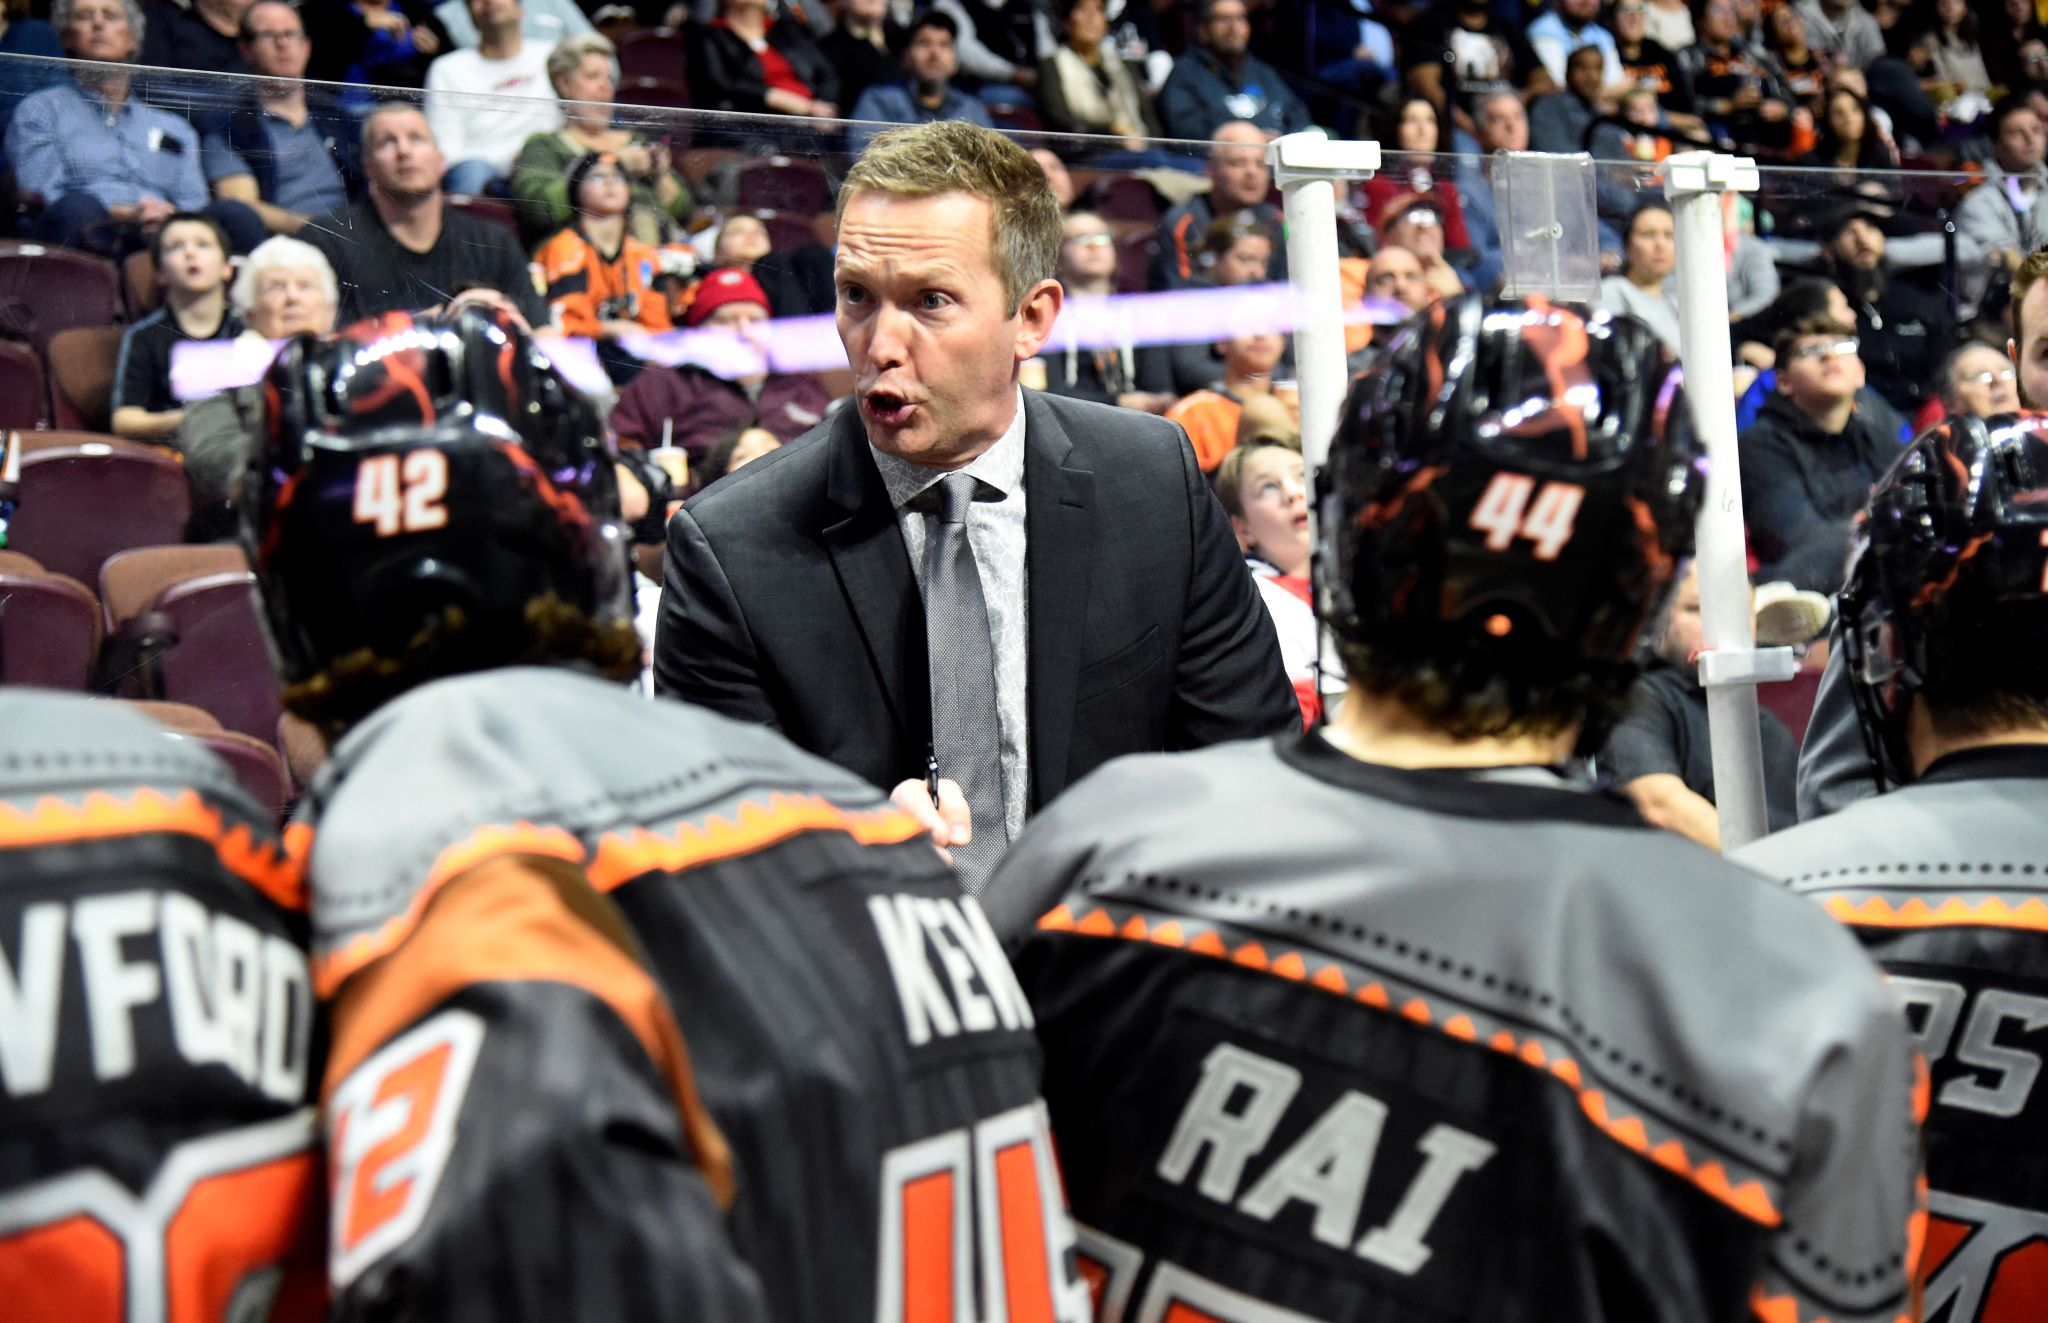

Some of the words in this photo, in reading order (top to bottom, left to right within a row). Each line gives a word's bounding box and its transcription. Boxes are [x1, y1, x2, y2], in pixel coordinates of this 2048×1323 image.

[353, 446, 449, 538] 42
[1468, 471, 1584, 562] 44
[1156, 1042, 1496, 1275] RAI
